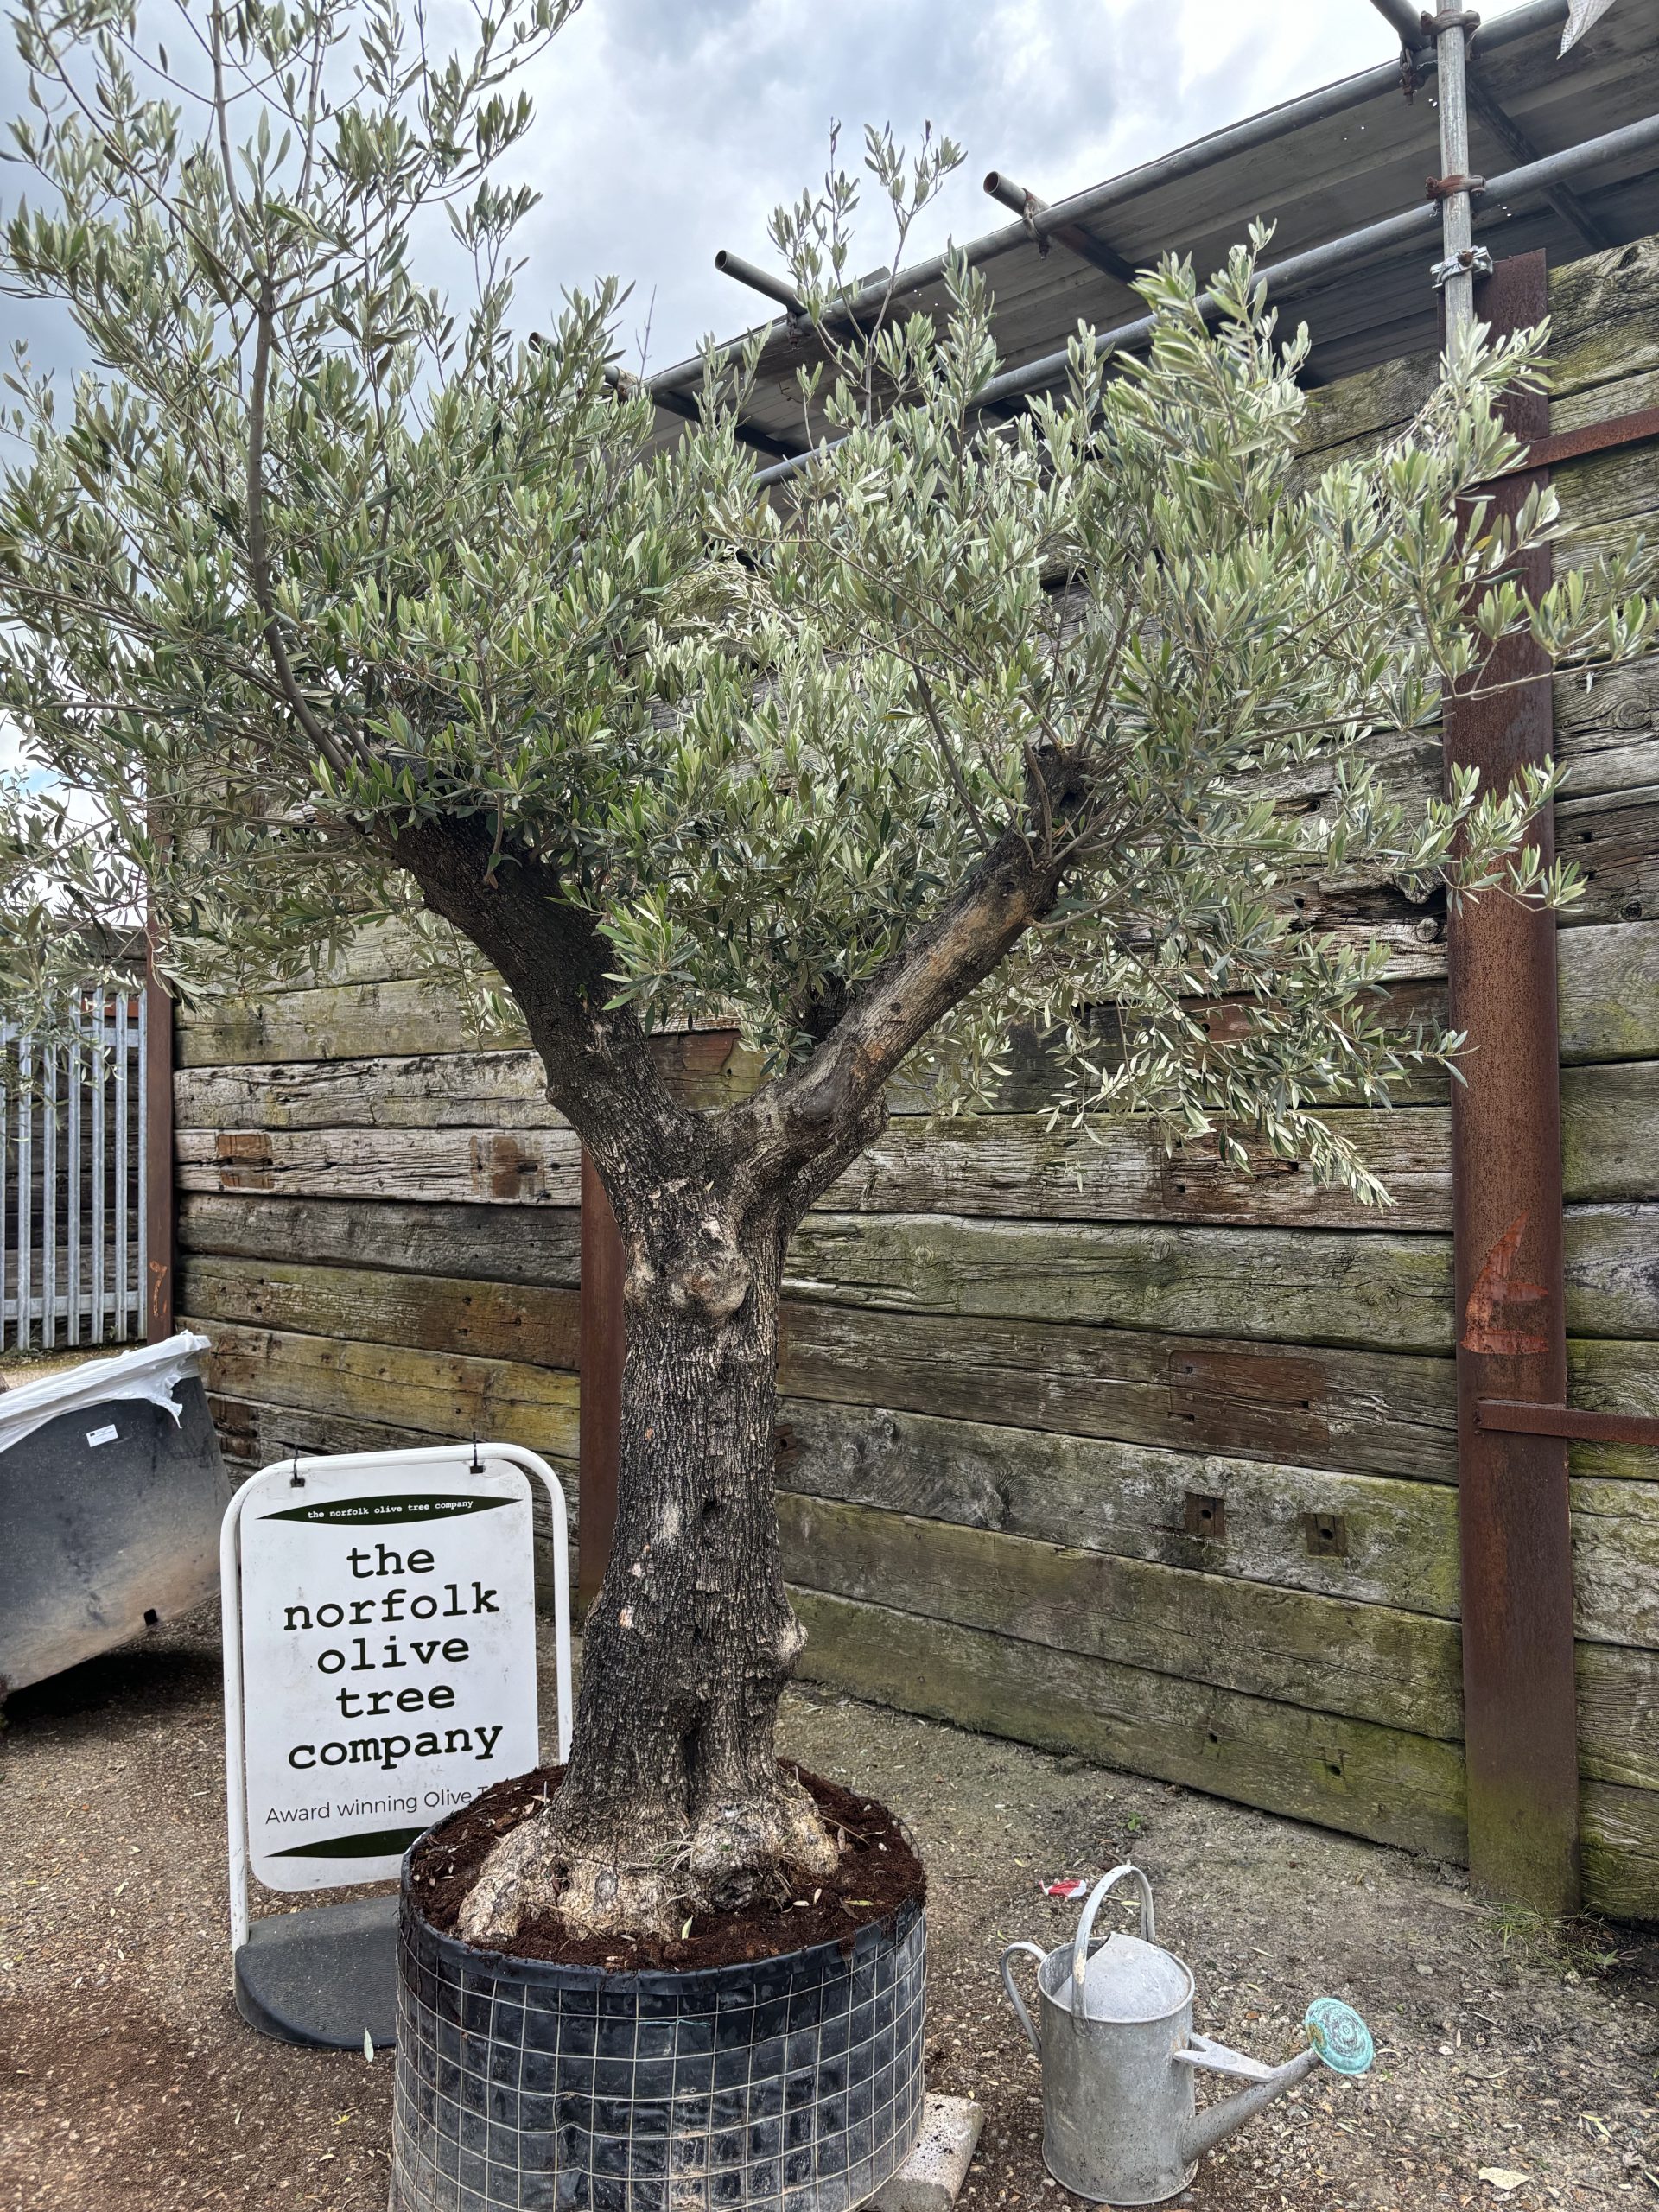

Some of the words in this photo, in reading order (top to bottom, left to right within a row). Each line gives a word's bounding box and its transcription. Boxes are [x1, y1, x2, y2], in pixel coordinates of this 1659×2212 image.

[307, 1510, 326, 1519] the
[329, 1506, 370, 1517] norfolk
[373, 1504, 403, 1515] olive
[407, 1502, 430, 1512] tree
[434, 1499, 474, 1511] company
[346, 1544, 435, 1579] the
[284, 1581, 499, 1631] norfolk
[317, 1635, 469, 1675] olive
[335, 1684, 455, 1719] tree
[288, 1725, 503, 1770] company
[265, 1801, 330, 1825] Award
[336, 1794, 418, 1819] winning
[423, 1789, 472, 1808] Olive
